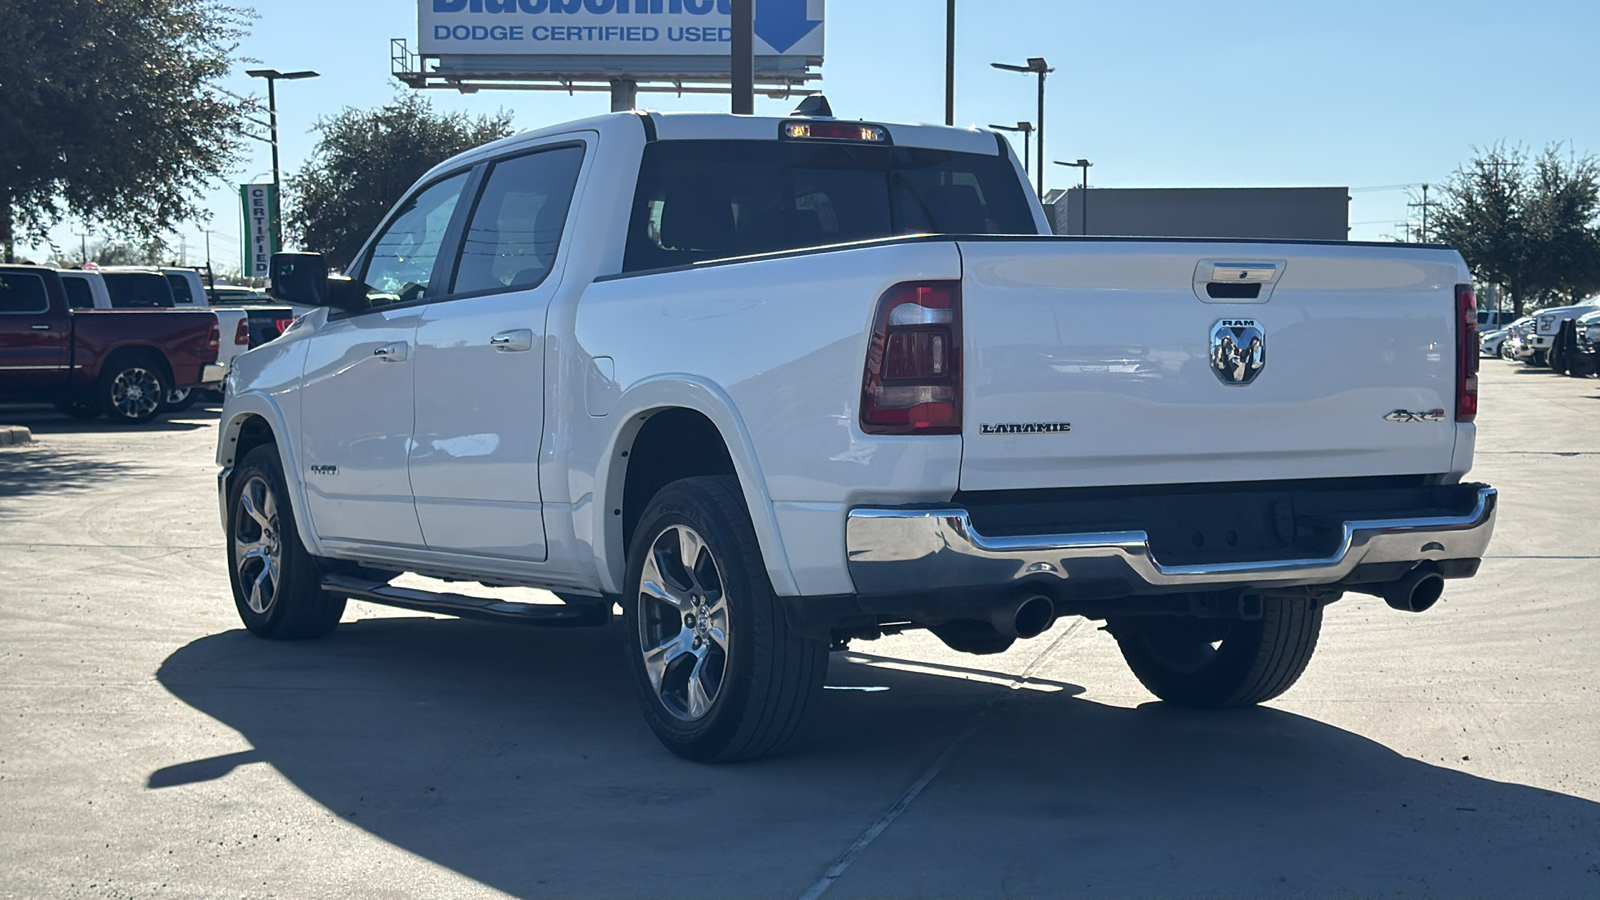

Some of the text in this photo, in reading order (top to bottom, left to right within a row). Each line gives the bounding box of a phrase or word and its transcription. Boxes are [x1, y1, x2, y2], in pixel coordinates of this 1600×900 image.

[434, 25, 732, 42] DODGE CERTIFIED USED
[252, 189, 267, 271] CERTIFIED
[980, 423, 1070, 435] LARAMIE
